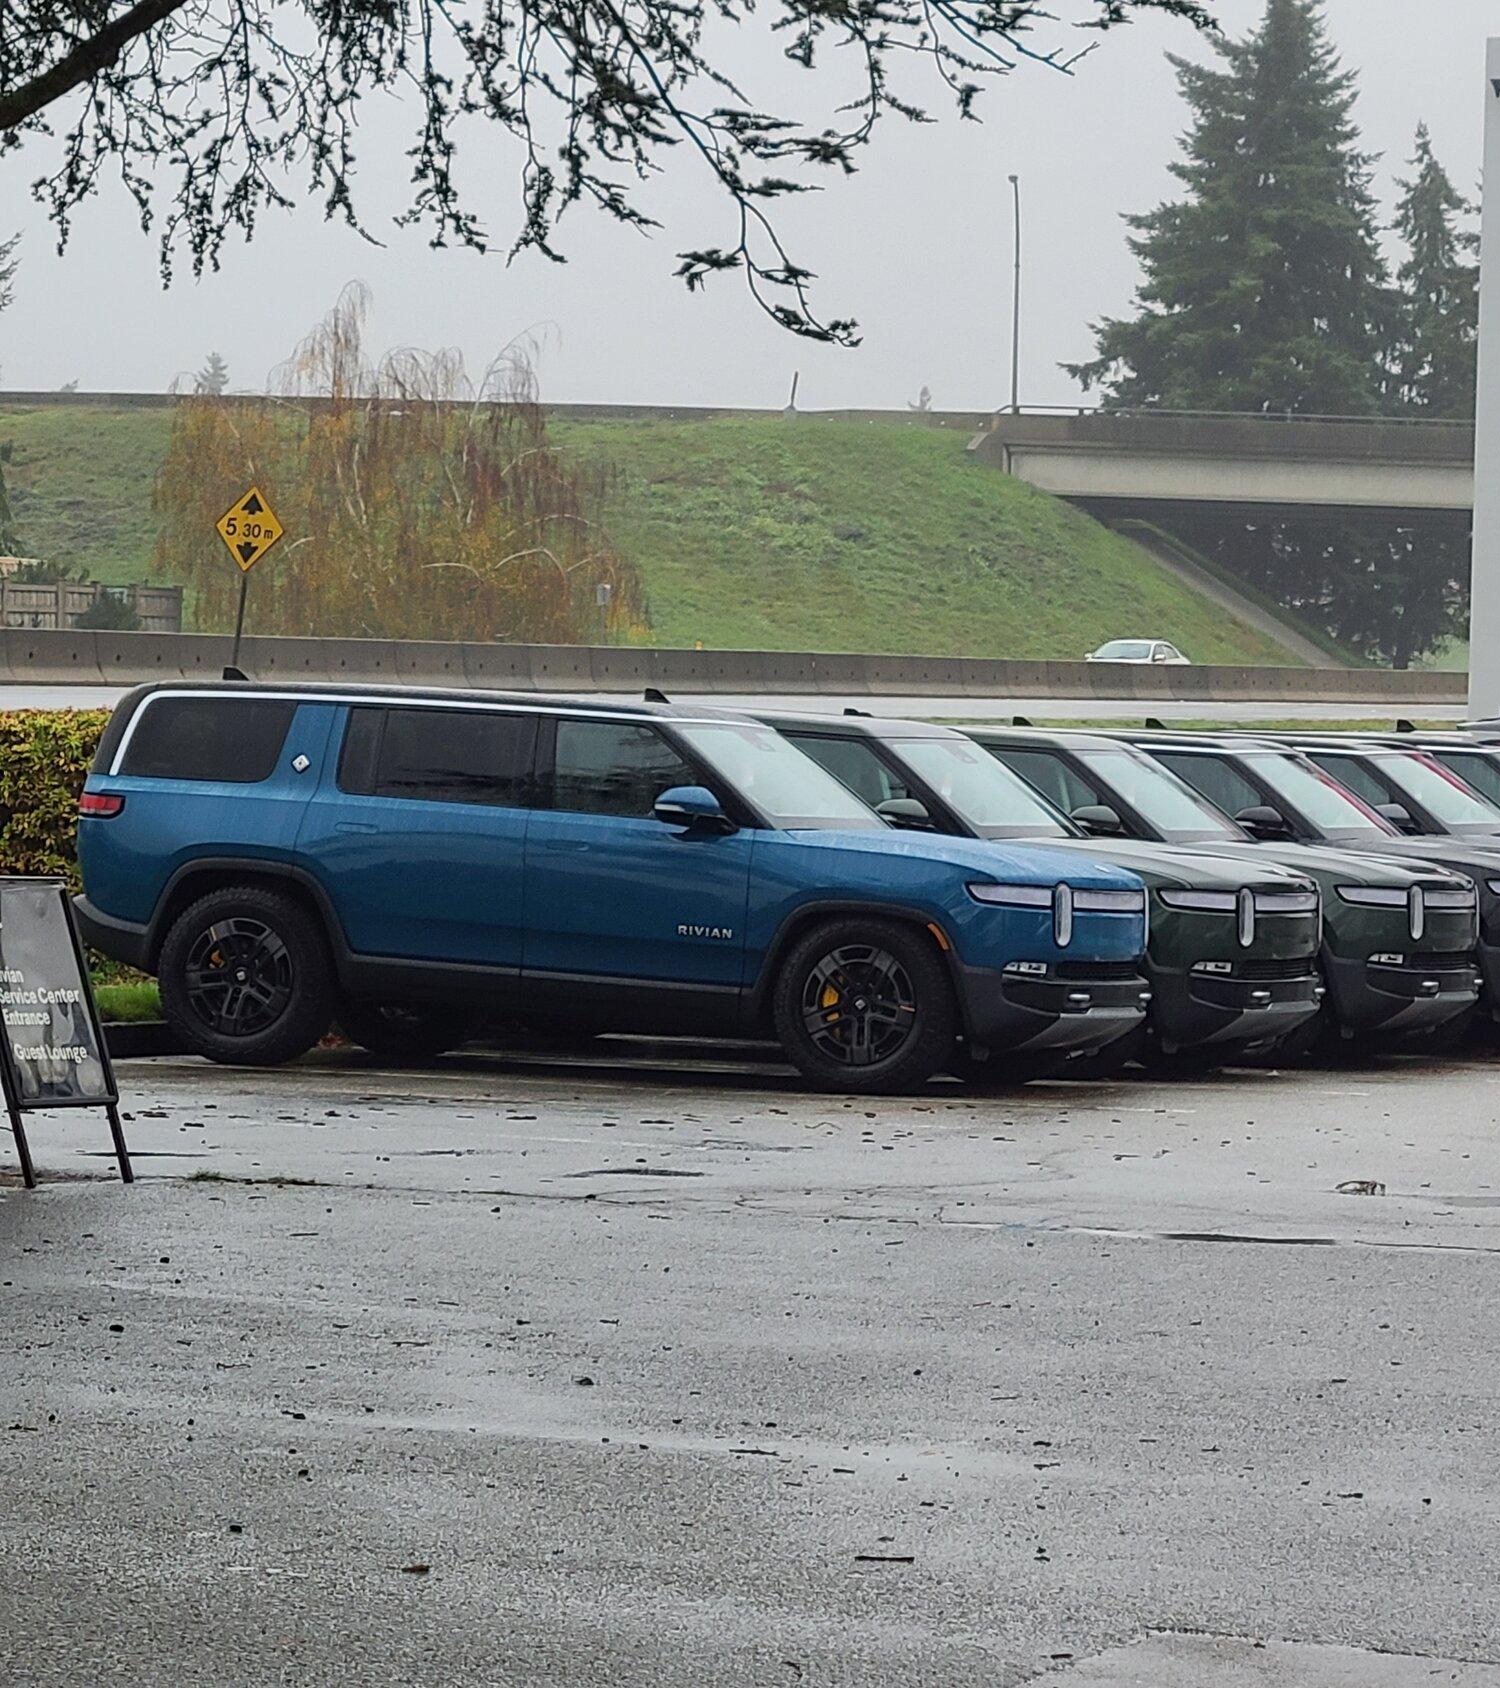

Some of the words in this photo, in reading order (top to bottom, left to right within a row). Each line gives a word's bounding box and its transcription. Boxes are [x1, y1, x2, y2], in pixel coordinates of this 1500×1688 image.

[264, 529, 274, 540] m
[678, 925, 732, 939] RIVIAN
[37, 986, 80, 1004] Center
[2, 1008, 51, 1026] Entrance
[14, 1043, 47, 1060] Guest
[45, 1044, 88, 1064] Lounge
